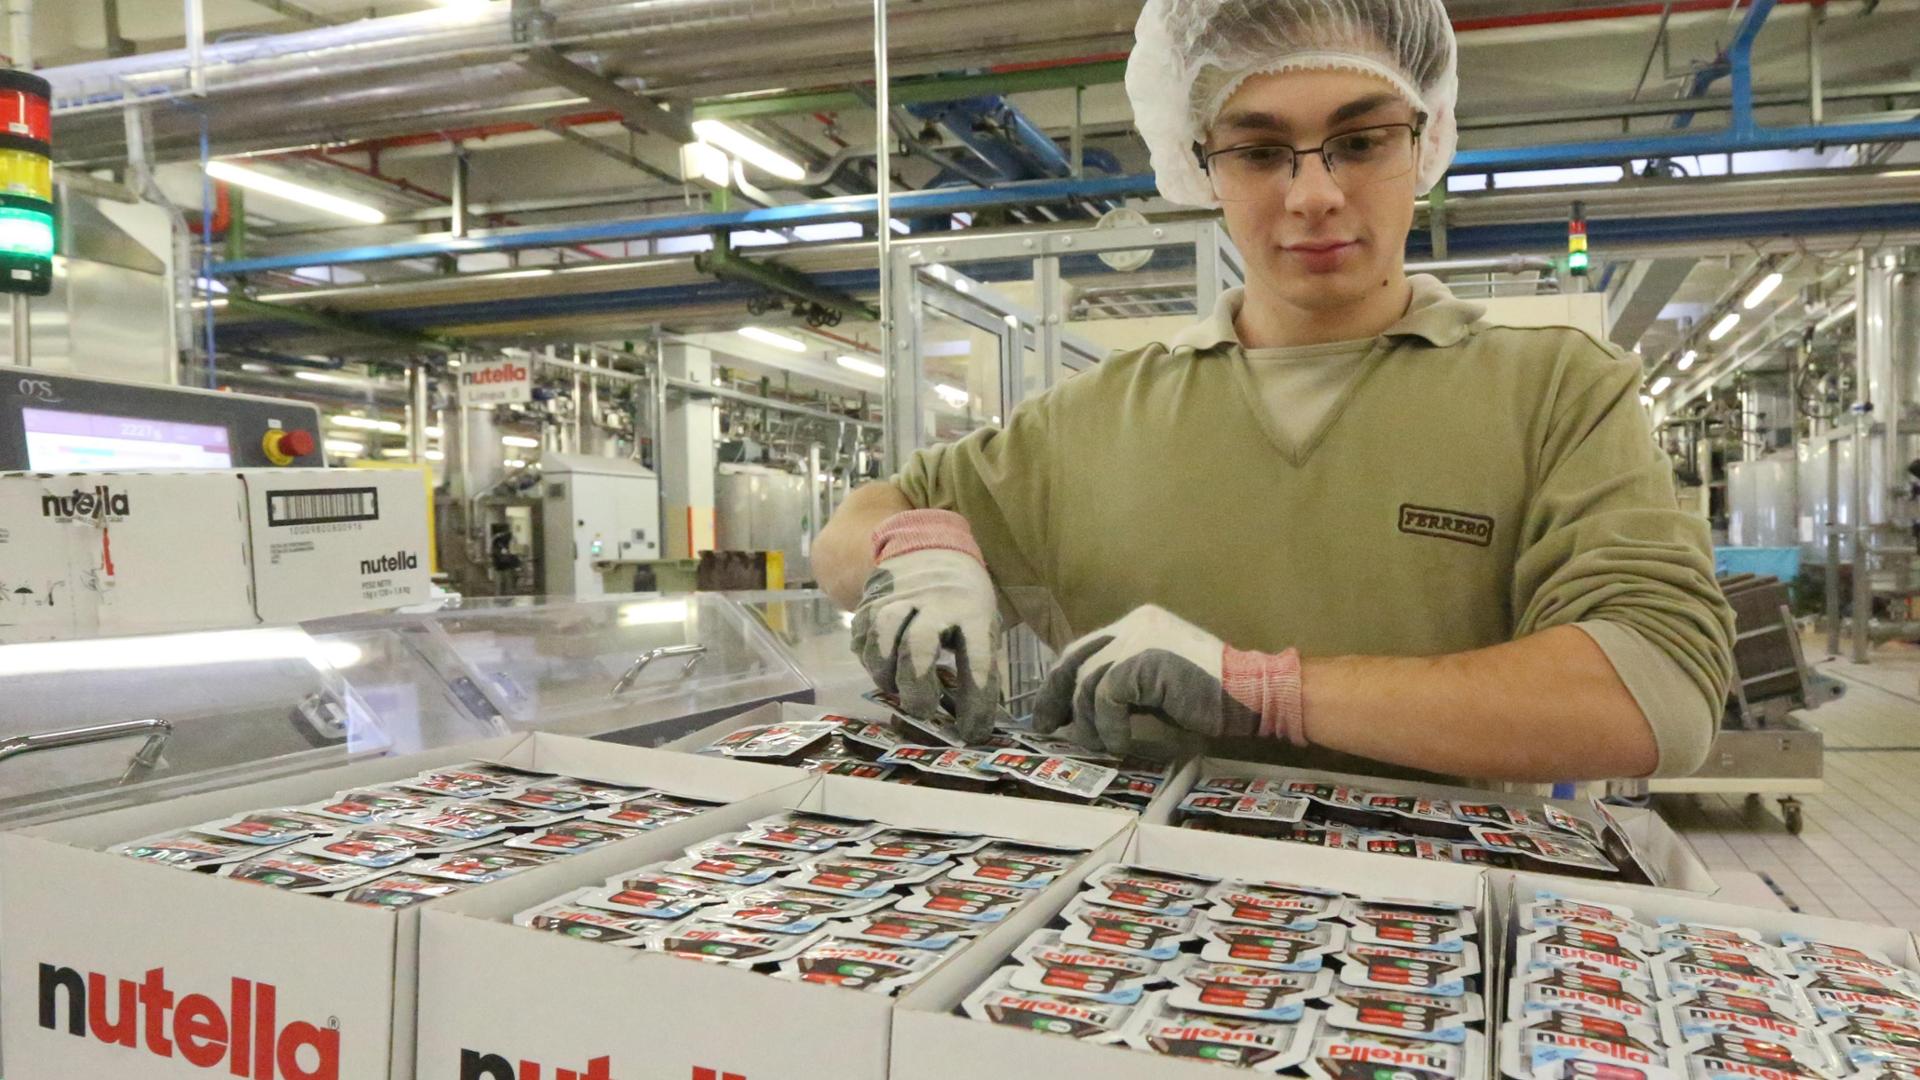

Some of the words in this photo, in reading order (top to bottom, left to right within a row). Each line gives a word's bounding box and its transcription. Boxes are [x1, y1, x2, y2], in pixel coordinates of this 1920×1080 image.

[463, 363, 526, 386] nutella
[1404, 511, 1488, 537] FERRERO
[360, 550, 418, 575] nutella
[1545, 946, 1638, 970] nutella
[1680, 965, 1775, 988] nutella
[1540, 986, 1642, 1015] nutella
[38, 962, 340, 1080] nutella
[1690, 1009, 1797, 1037] nutella
[1161, 1027, 1274, 1045] nutella
[1537, 1032, 1649, 1064] nutella
[1329, 1045, 1447, 1070] nutella
